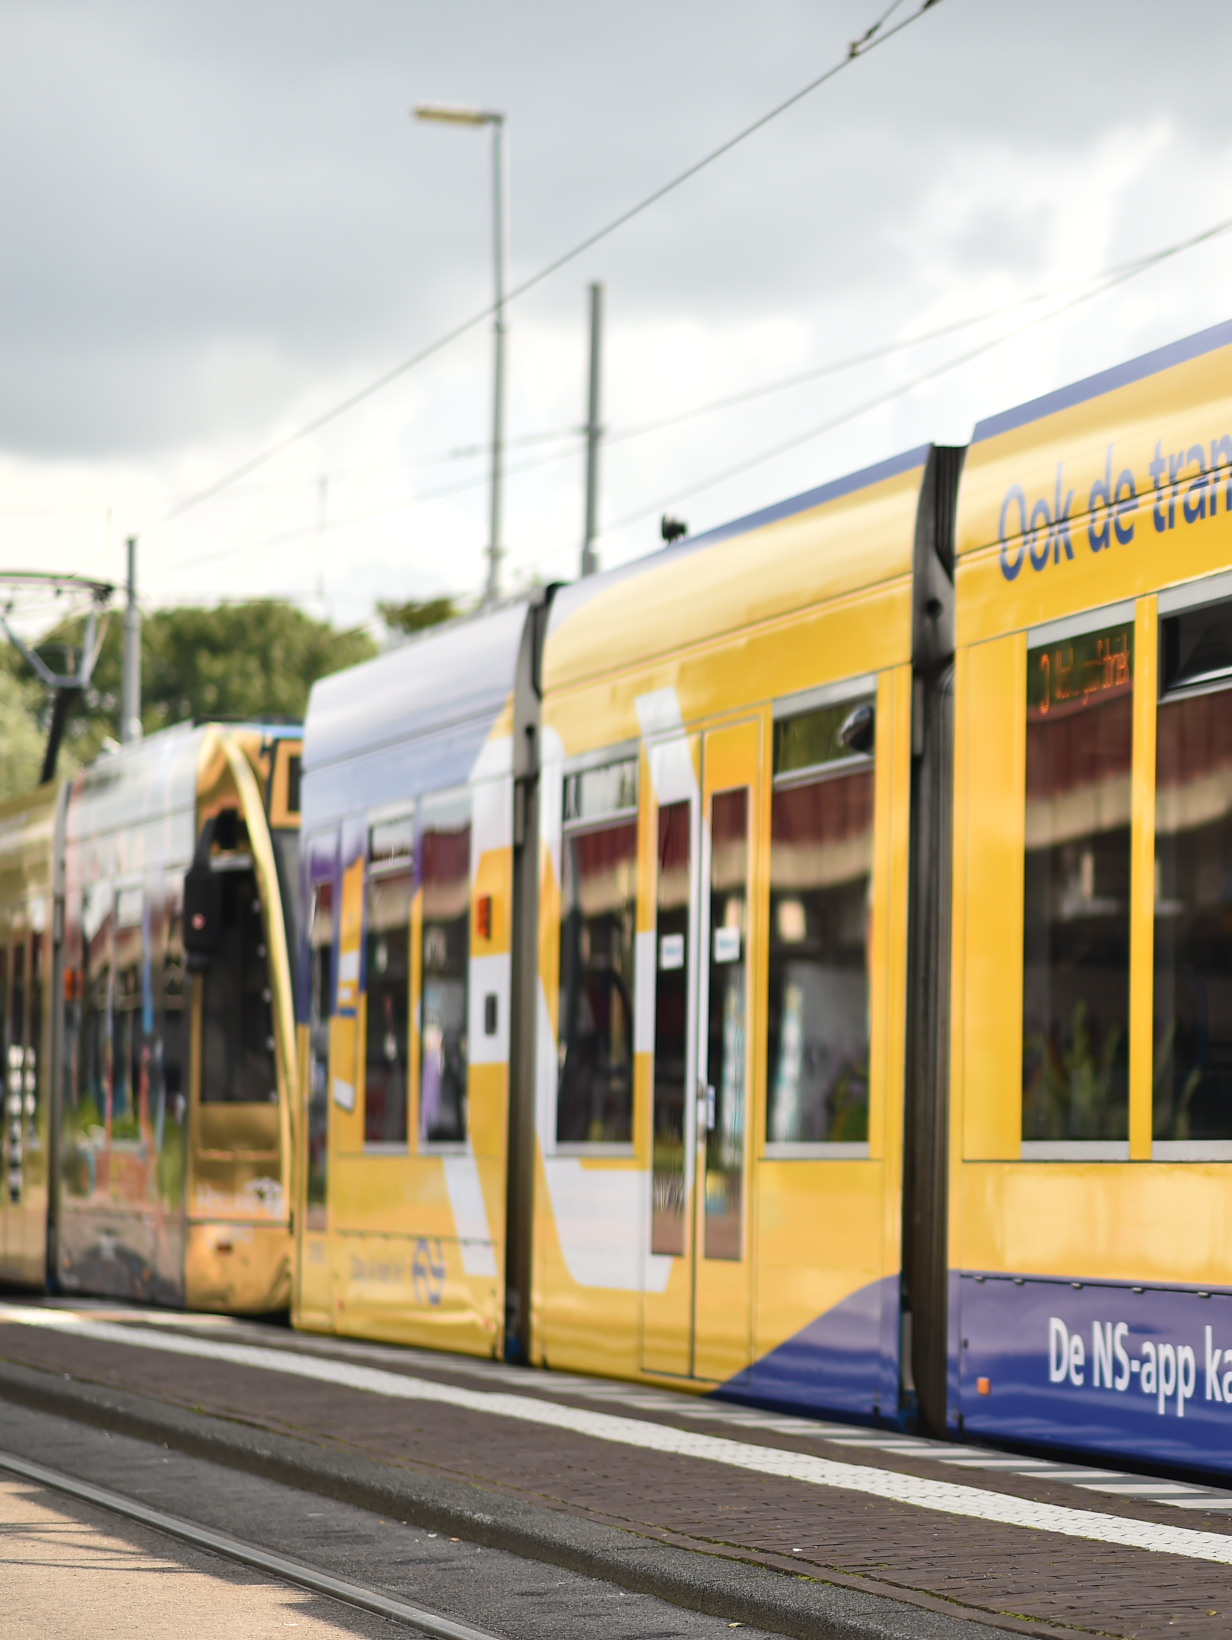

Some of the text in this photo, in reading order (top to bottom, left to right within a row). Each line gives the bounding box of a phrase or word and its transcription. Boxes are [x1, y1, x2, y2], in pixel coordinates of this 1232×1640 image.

[998, 461, 1075, 581] Ook
[1088, 443, 1140, 553] de
[1048, 1316, 1085, 1386] De
[1092, 1320, 1196, 1417] NS-app
